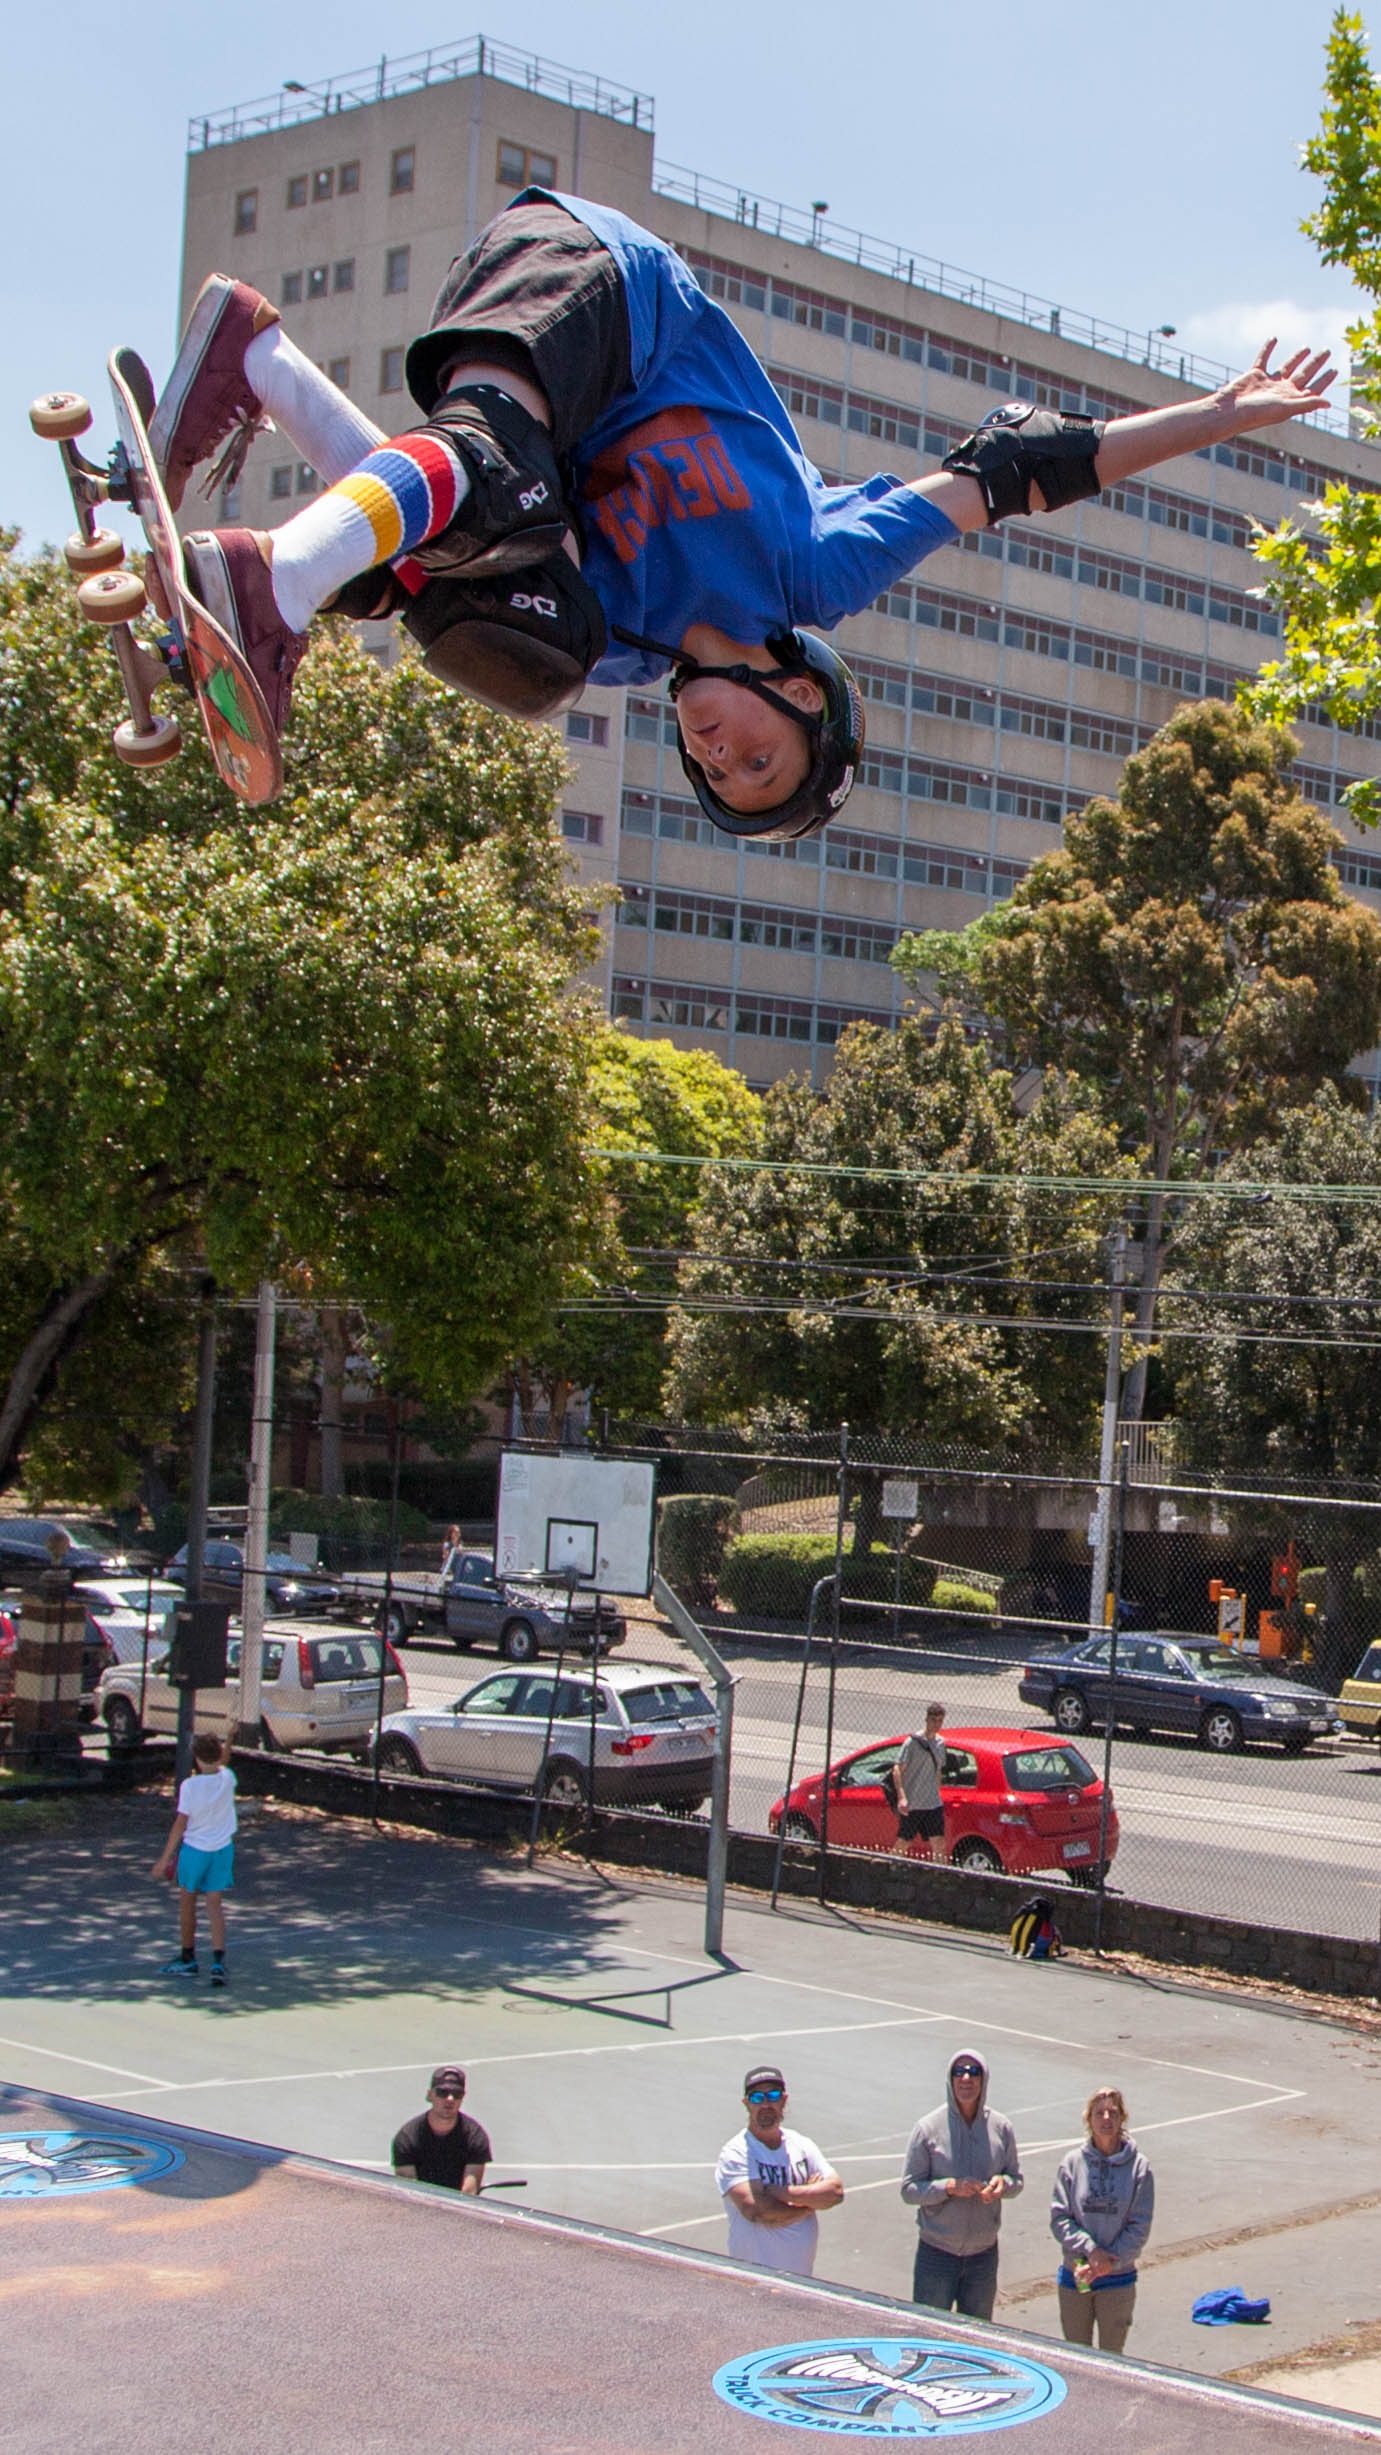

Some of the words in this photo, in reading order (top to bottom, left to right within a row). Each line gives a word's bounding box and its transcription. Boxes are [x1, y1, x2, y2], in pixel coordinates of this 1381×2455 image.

[725, 2374, 772, 2409] TRUCK
[767, 2408, 942, 2433] COMPANY
[786, 2353, 1014, 2416] INDEPENDENT
